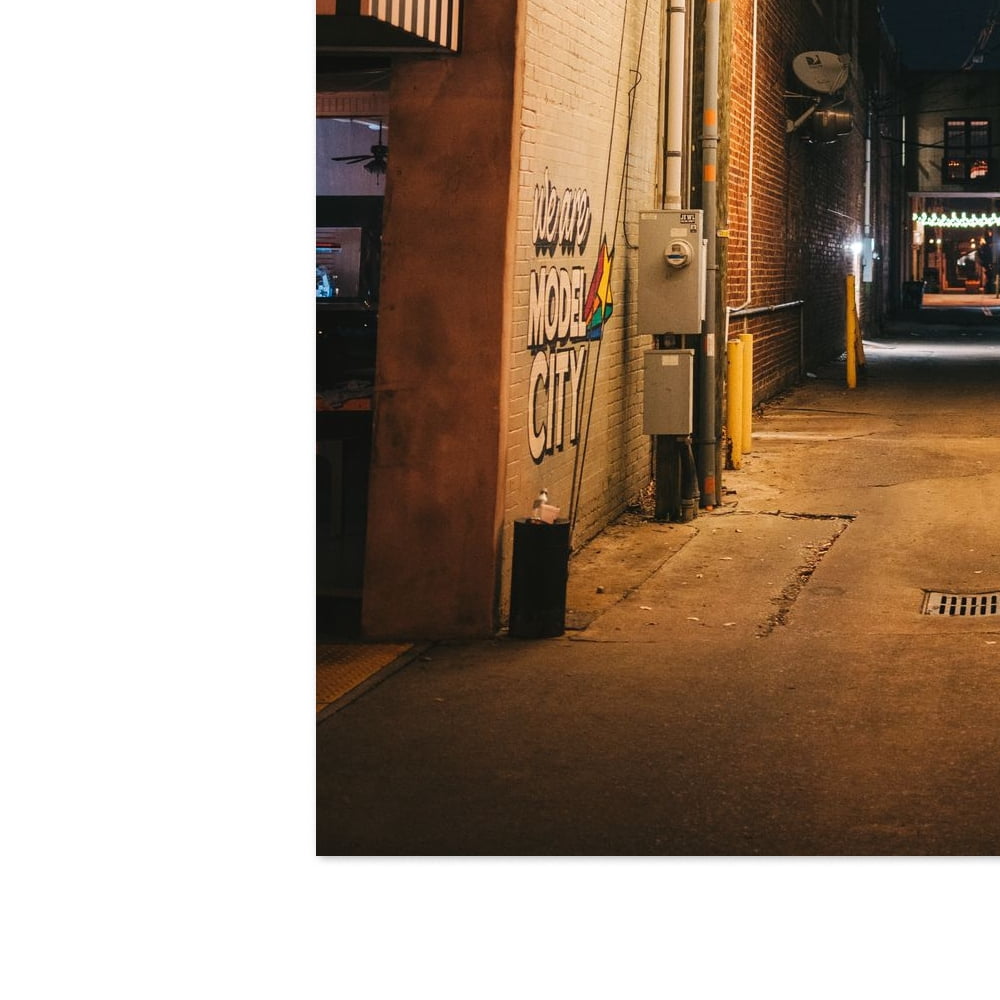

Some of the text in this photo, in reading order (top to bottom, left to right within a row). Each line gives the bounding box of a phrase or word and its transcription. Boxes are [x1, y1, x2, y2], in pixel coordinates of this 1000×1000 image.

[559, 187, 592, 256] are
[527, 266, 588, 349] MODEL
[528, 345, 588, 465] CITY
